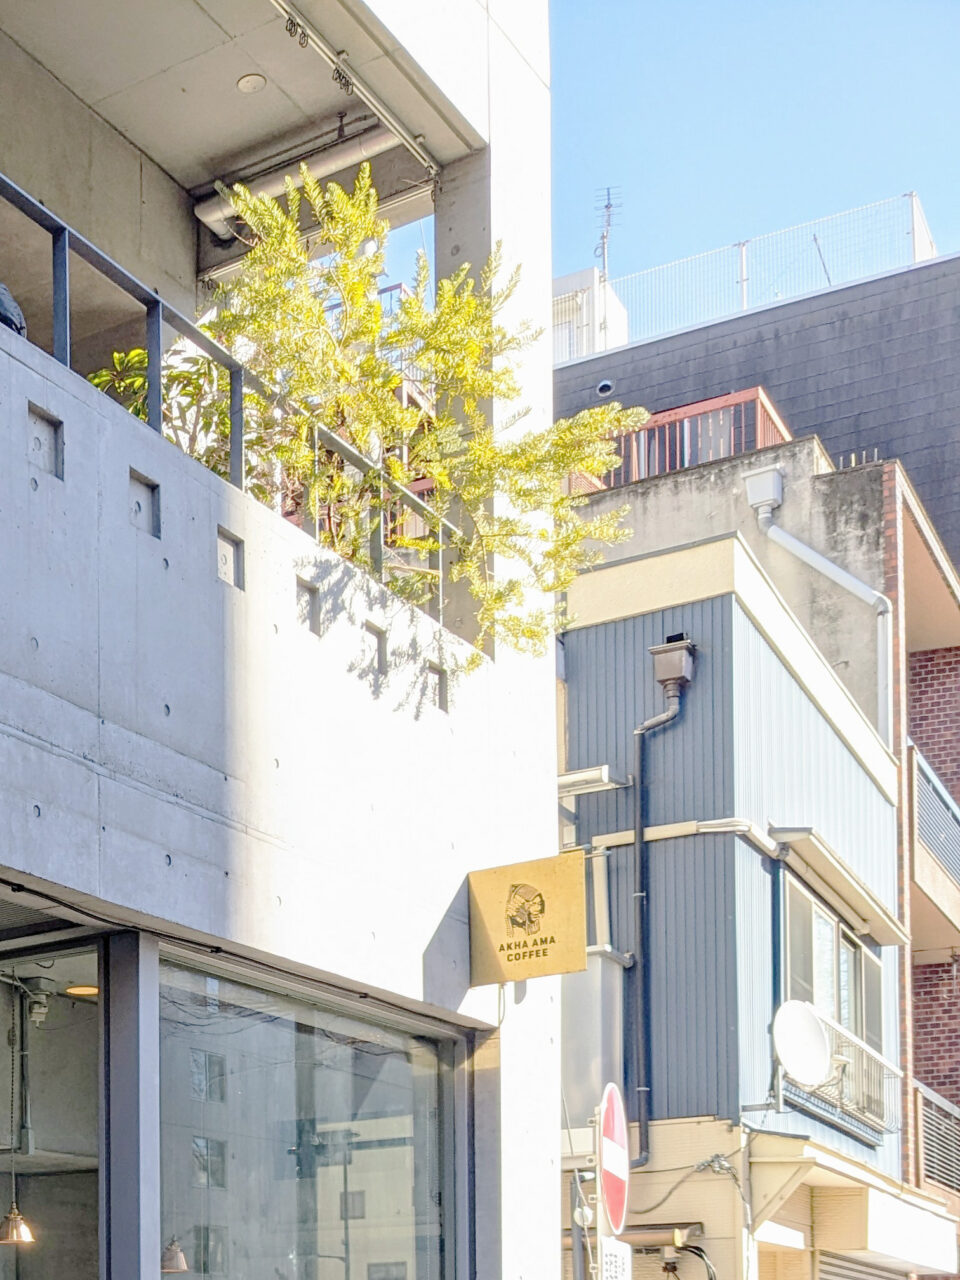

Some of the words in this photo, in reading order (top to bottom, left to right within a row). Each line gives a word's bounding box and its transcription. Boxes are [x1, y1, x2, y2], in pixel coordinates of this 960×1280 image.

[498, 940, 528, 953] AKHA
[532, 935, 556, 947] AMA
[506, 948, 549, 962] COFFEE
